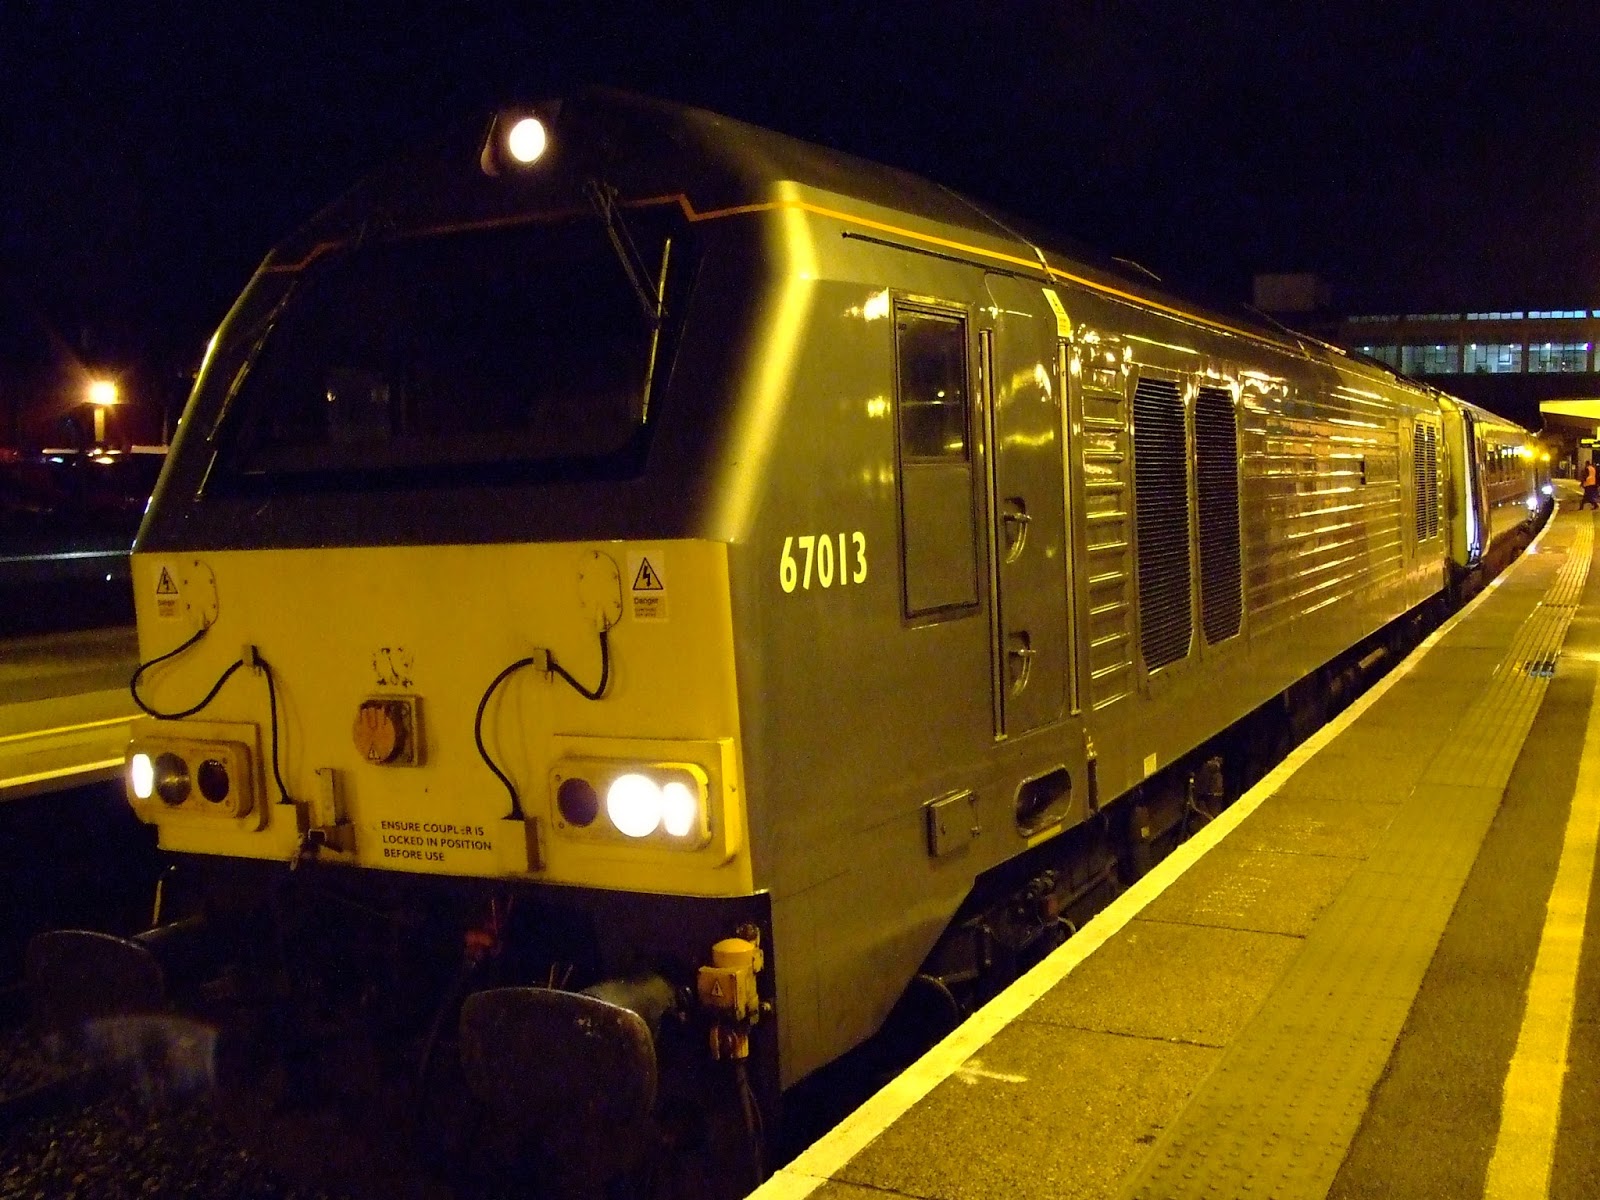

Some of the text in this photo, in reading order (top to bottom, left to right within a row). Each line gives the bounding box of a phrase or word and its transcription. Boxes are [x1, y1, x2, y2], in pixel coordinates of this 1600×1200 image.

[780, 531, 867, 593] 67013
[381, 821, 420, 832] ENSURE
[475, 827, 484, 836] IS
[382, 835, 492, 850] LOCKED IN POSITION
[384, 848, 445, 861] BEFORE USE
